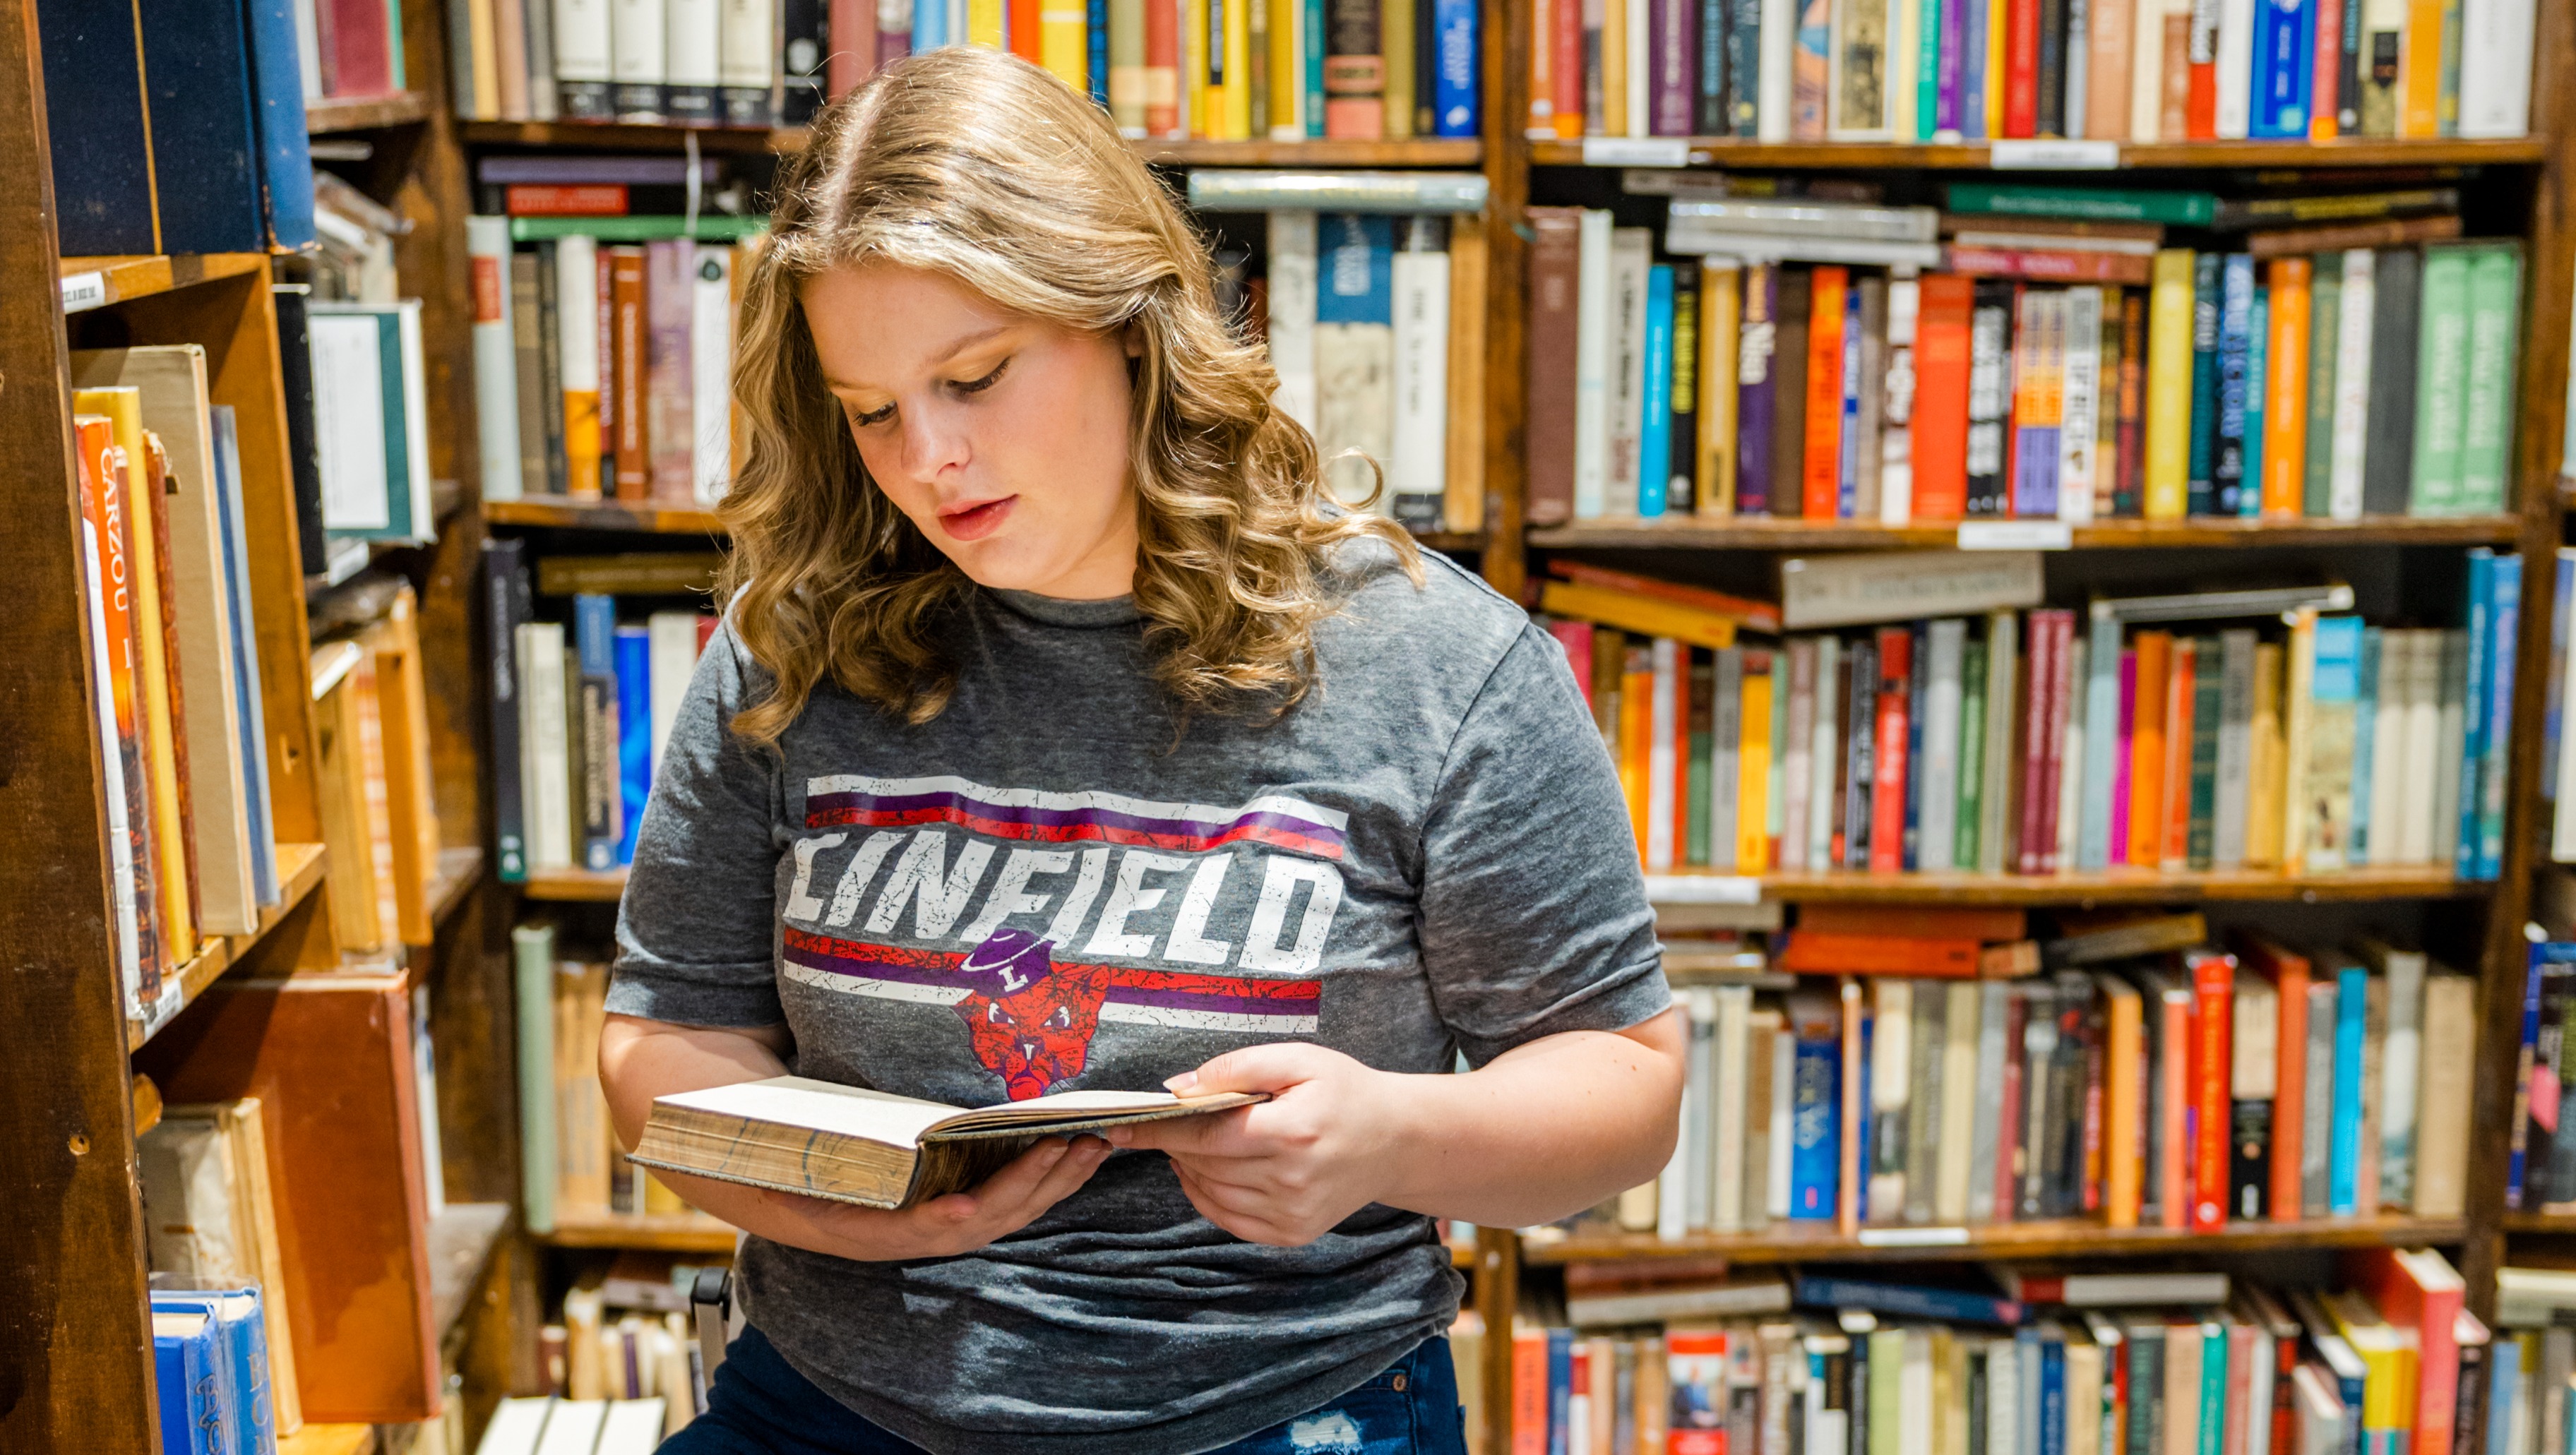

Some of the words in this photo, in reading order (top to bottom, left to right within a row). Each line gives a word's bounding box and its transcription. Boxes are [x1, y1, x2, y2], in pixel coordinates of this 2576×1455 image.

[100, 446, 129, 612] CARZOU
[782, 829, 1344, 975] LINFIELD
[997, 964, 1029, 993] L
